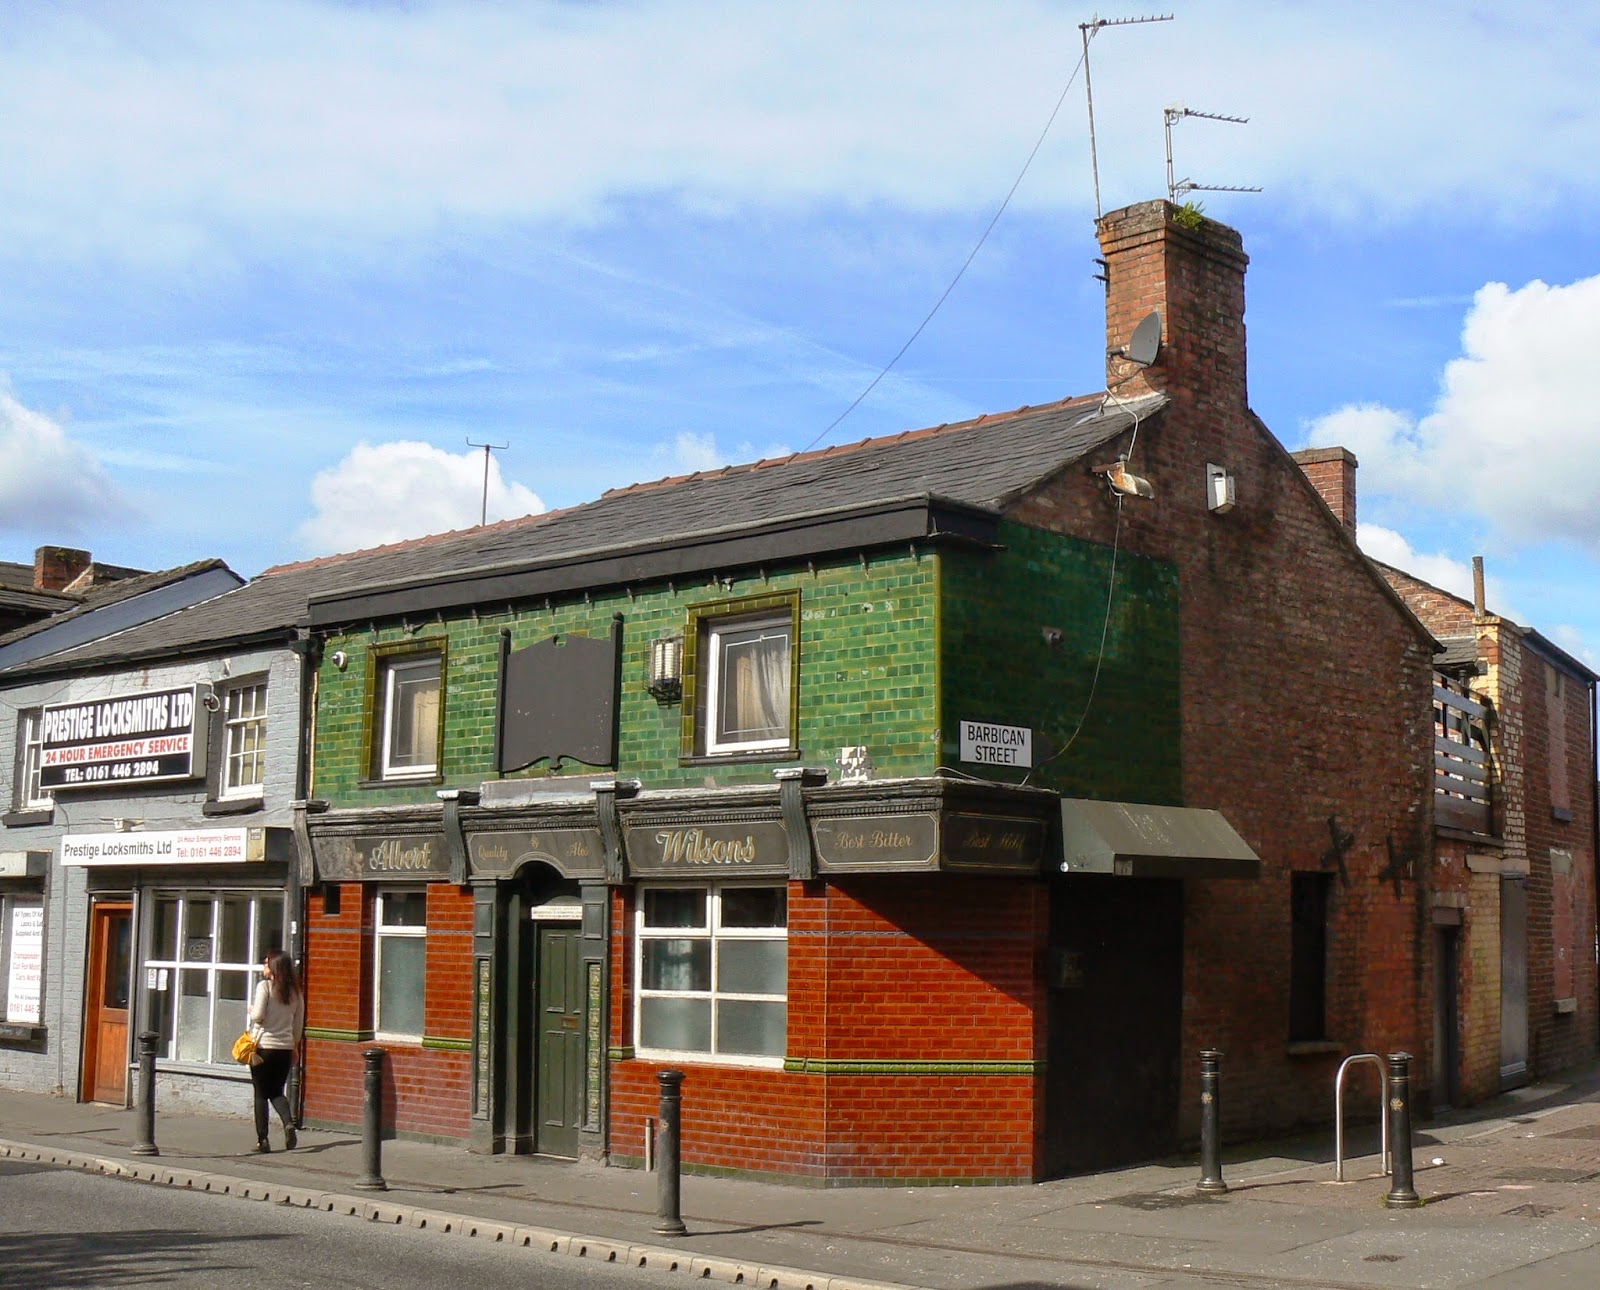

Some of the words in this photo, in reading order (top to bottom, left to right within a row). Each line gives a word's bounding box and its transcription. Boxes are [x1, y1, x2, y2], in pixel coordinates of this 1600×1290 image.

[44, 706, 94, 743] PRESTIGE
[96, 695, 168, 737] LOCKSMITHS
[170, 692, 193, 728] LTD
[967, 725, 1025, 746] BARBICAN
[45, 752, 57, 764] 24
[59, 748, 85, 763] HOUR
[88, 742, 144, 759] EMERGENCY
[148, 737, 188, 753] SERVICE
[975, 745, 1017, 764] STREET
[65, 768, 84, 782] TEL:
[86, 765, 109, 780] 0161
[112, 763, 131, 778] 446
[134, 760, 159, 776] 2894
[196, 835, 222, 844] Emergency
[223, 834, 241, 842] Service
[655, 827, 756, 864] Wilsons
[834, 830, 864, 849] Best
[869, 830, 913, 848] Bitter
[64, 844, 99, 859] Prestige
[102, 841, 154, 856] Locksmiths
[157, 841, 172, 854] Ltd
[177, 848, 188, 857] Tel:
[190, 847, 207, 857] 0161
[209, 847, 222, 857] 446
[224, 846, 241, 856] 2894
[369, 840, 431, 870] Albert
[478, 844, 508, 862] Quality
